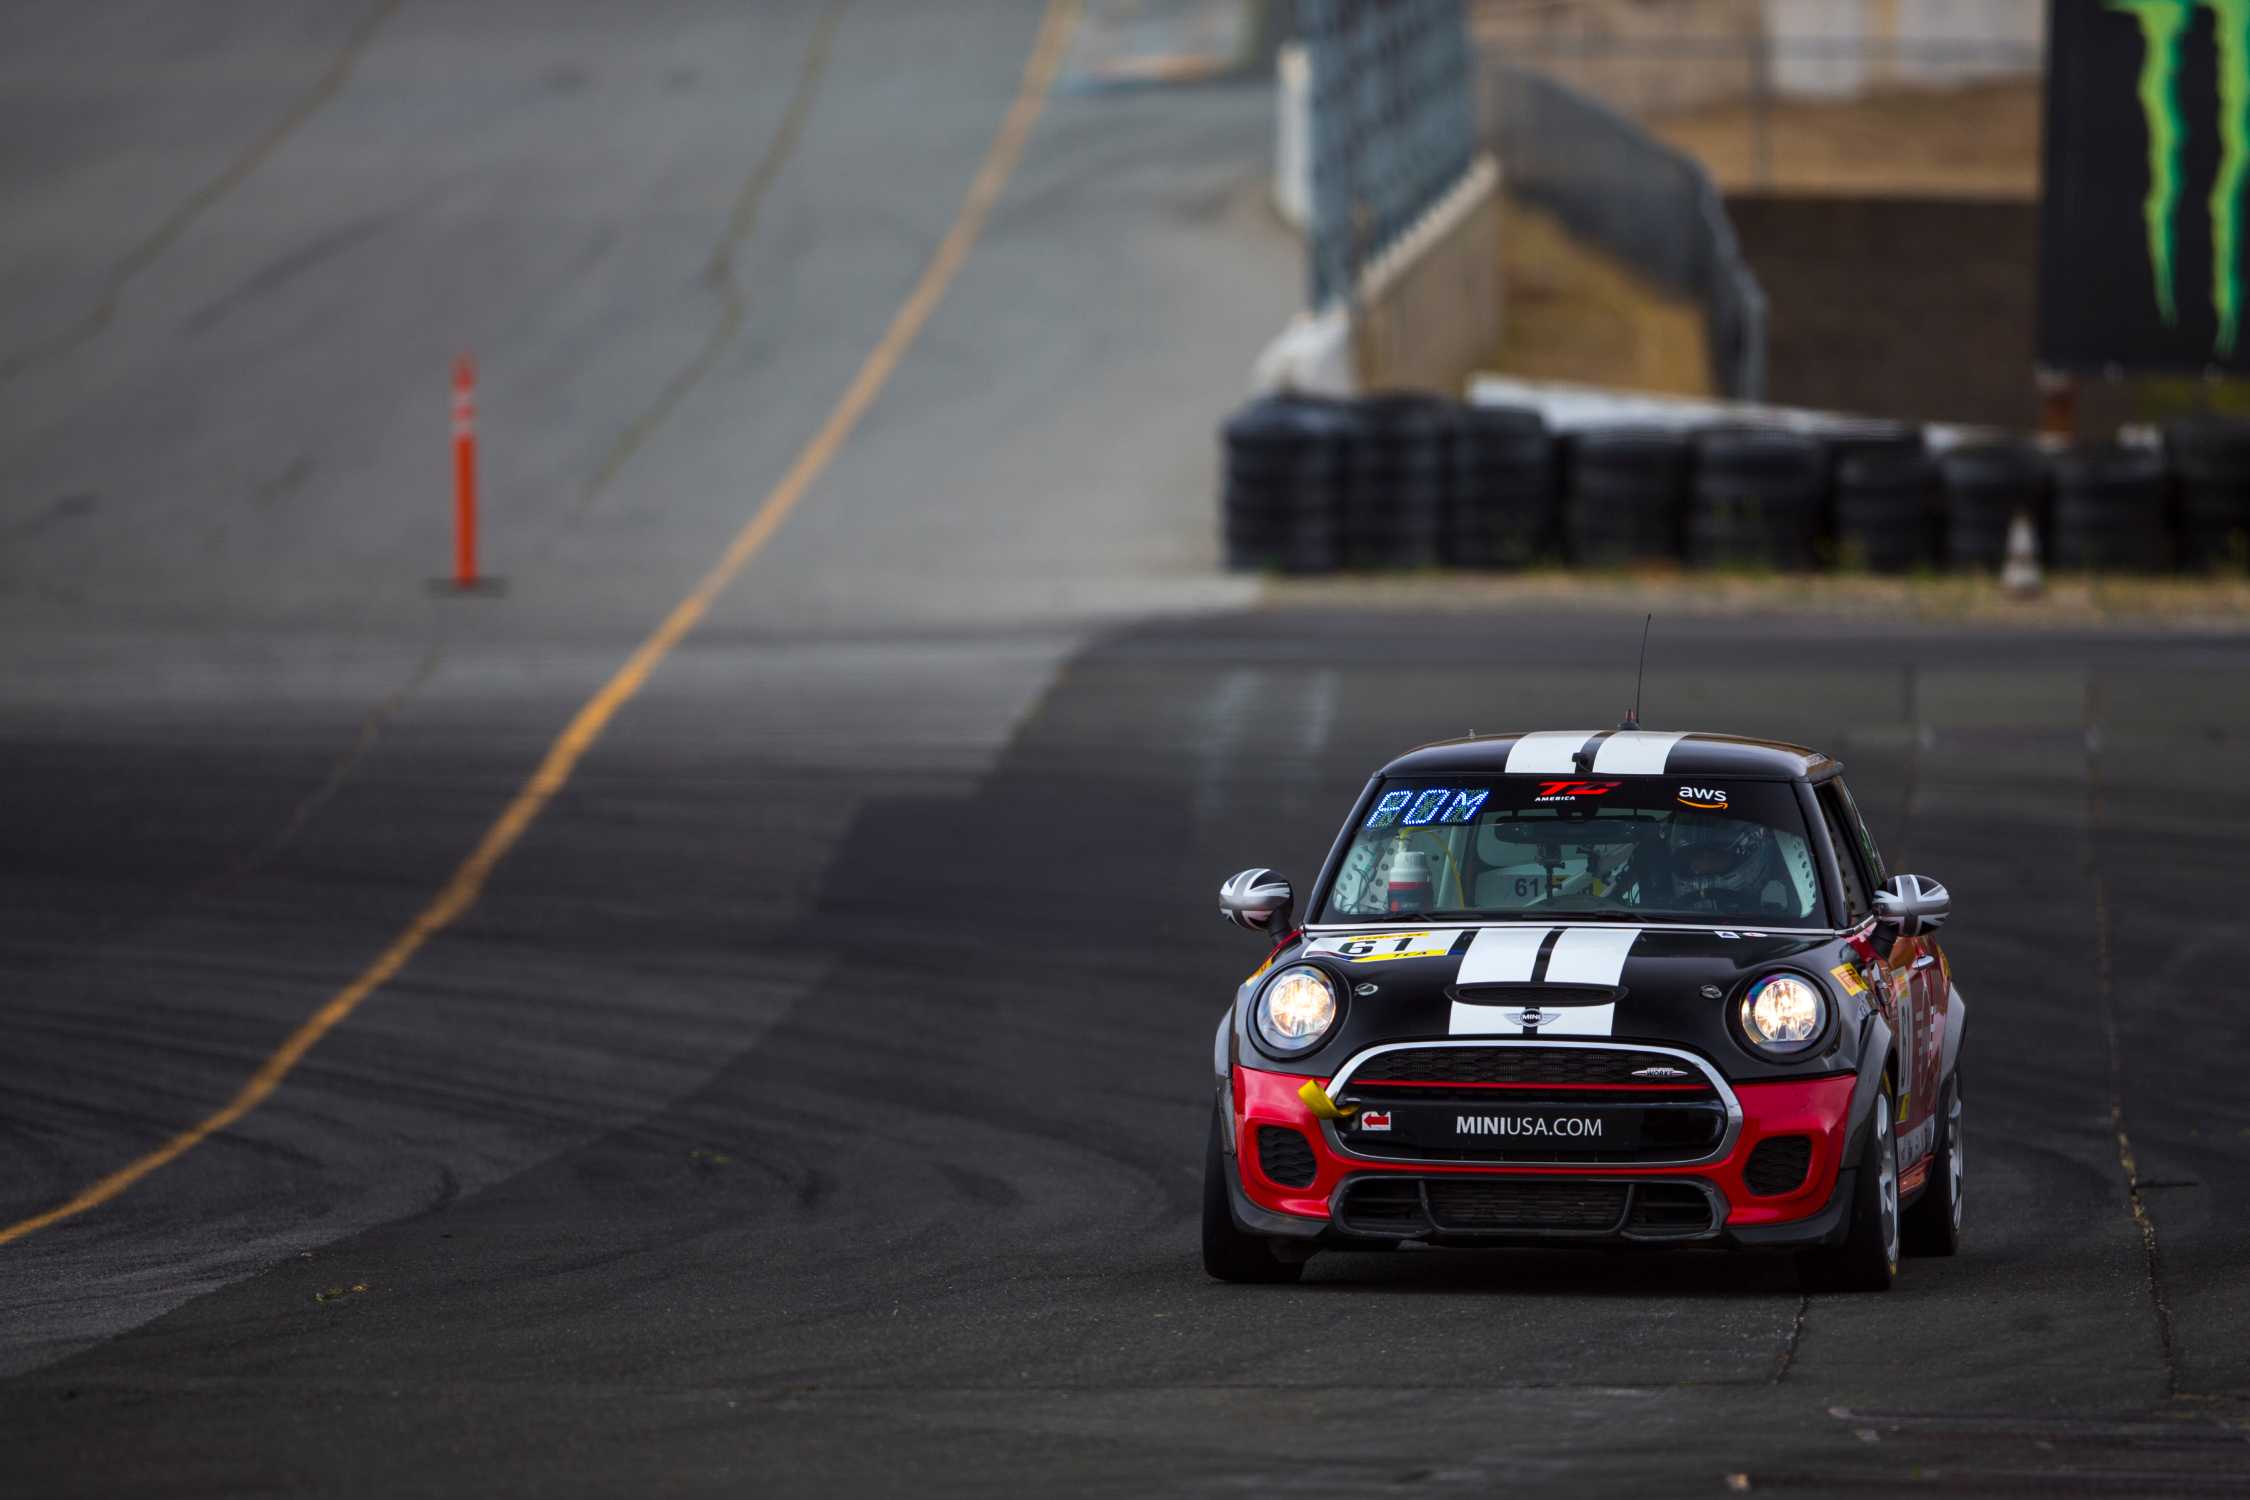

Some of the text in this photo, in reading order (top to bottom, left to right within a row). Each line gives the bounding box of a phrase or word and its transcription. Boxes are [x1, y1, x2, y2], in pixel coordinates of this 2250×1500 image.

[1679, 786, 1727, 801] aws
[1514, 878, 1540, 897] 61
[1338, 938, 1414, 955] 61
[1456, 1116, 1602, 1137] MINIUSA.COM
